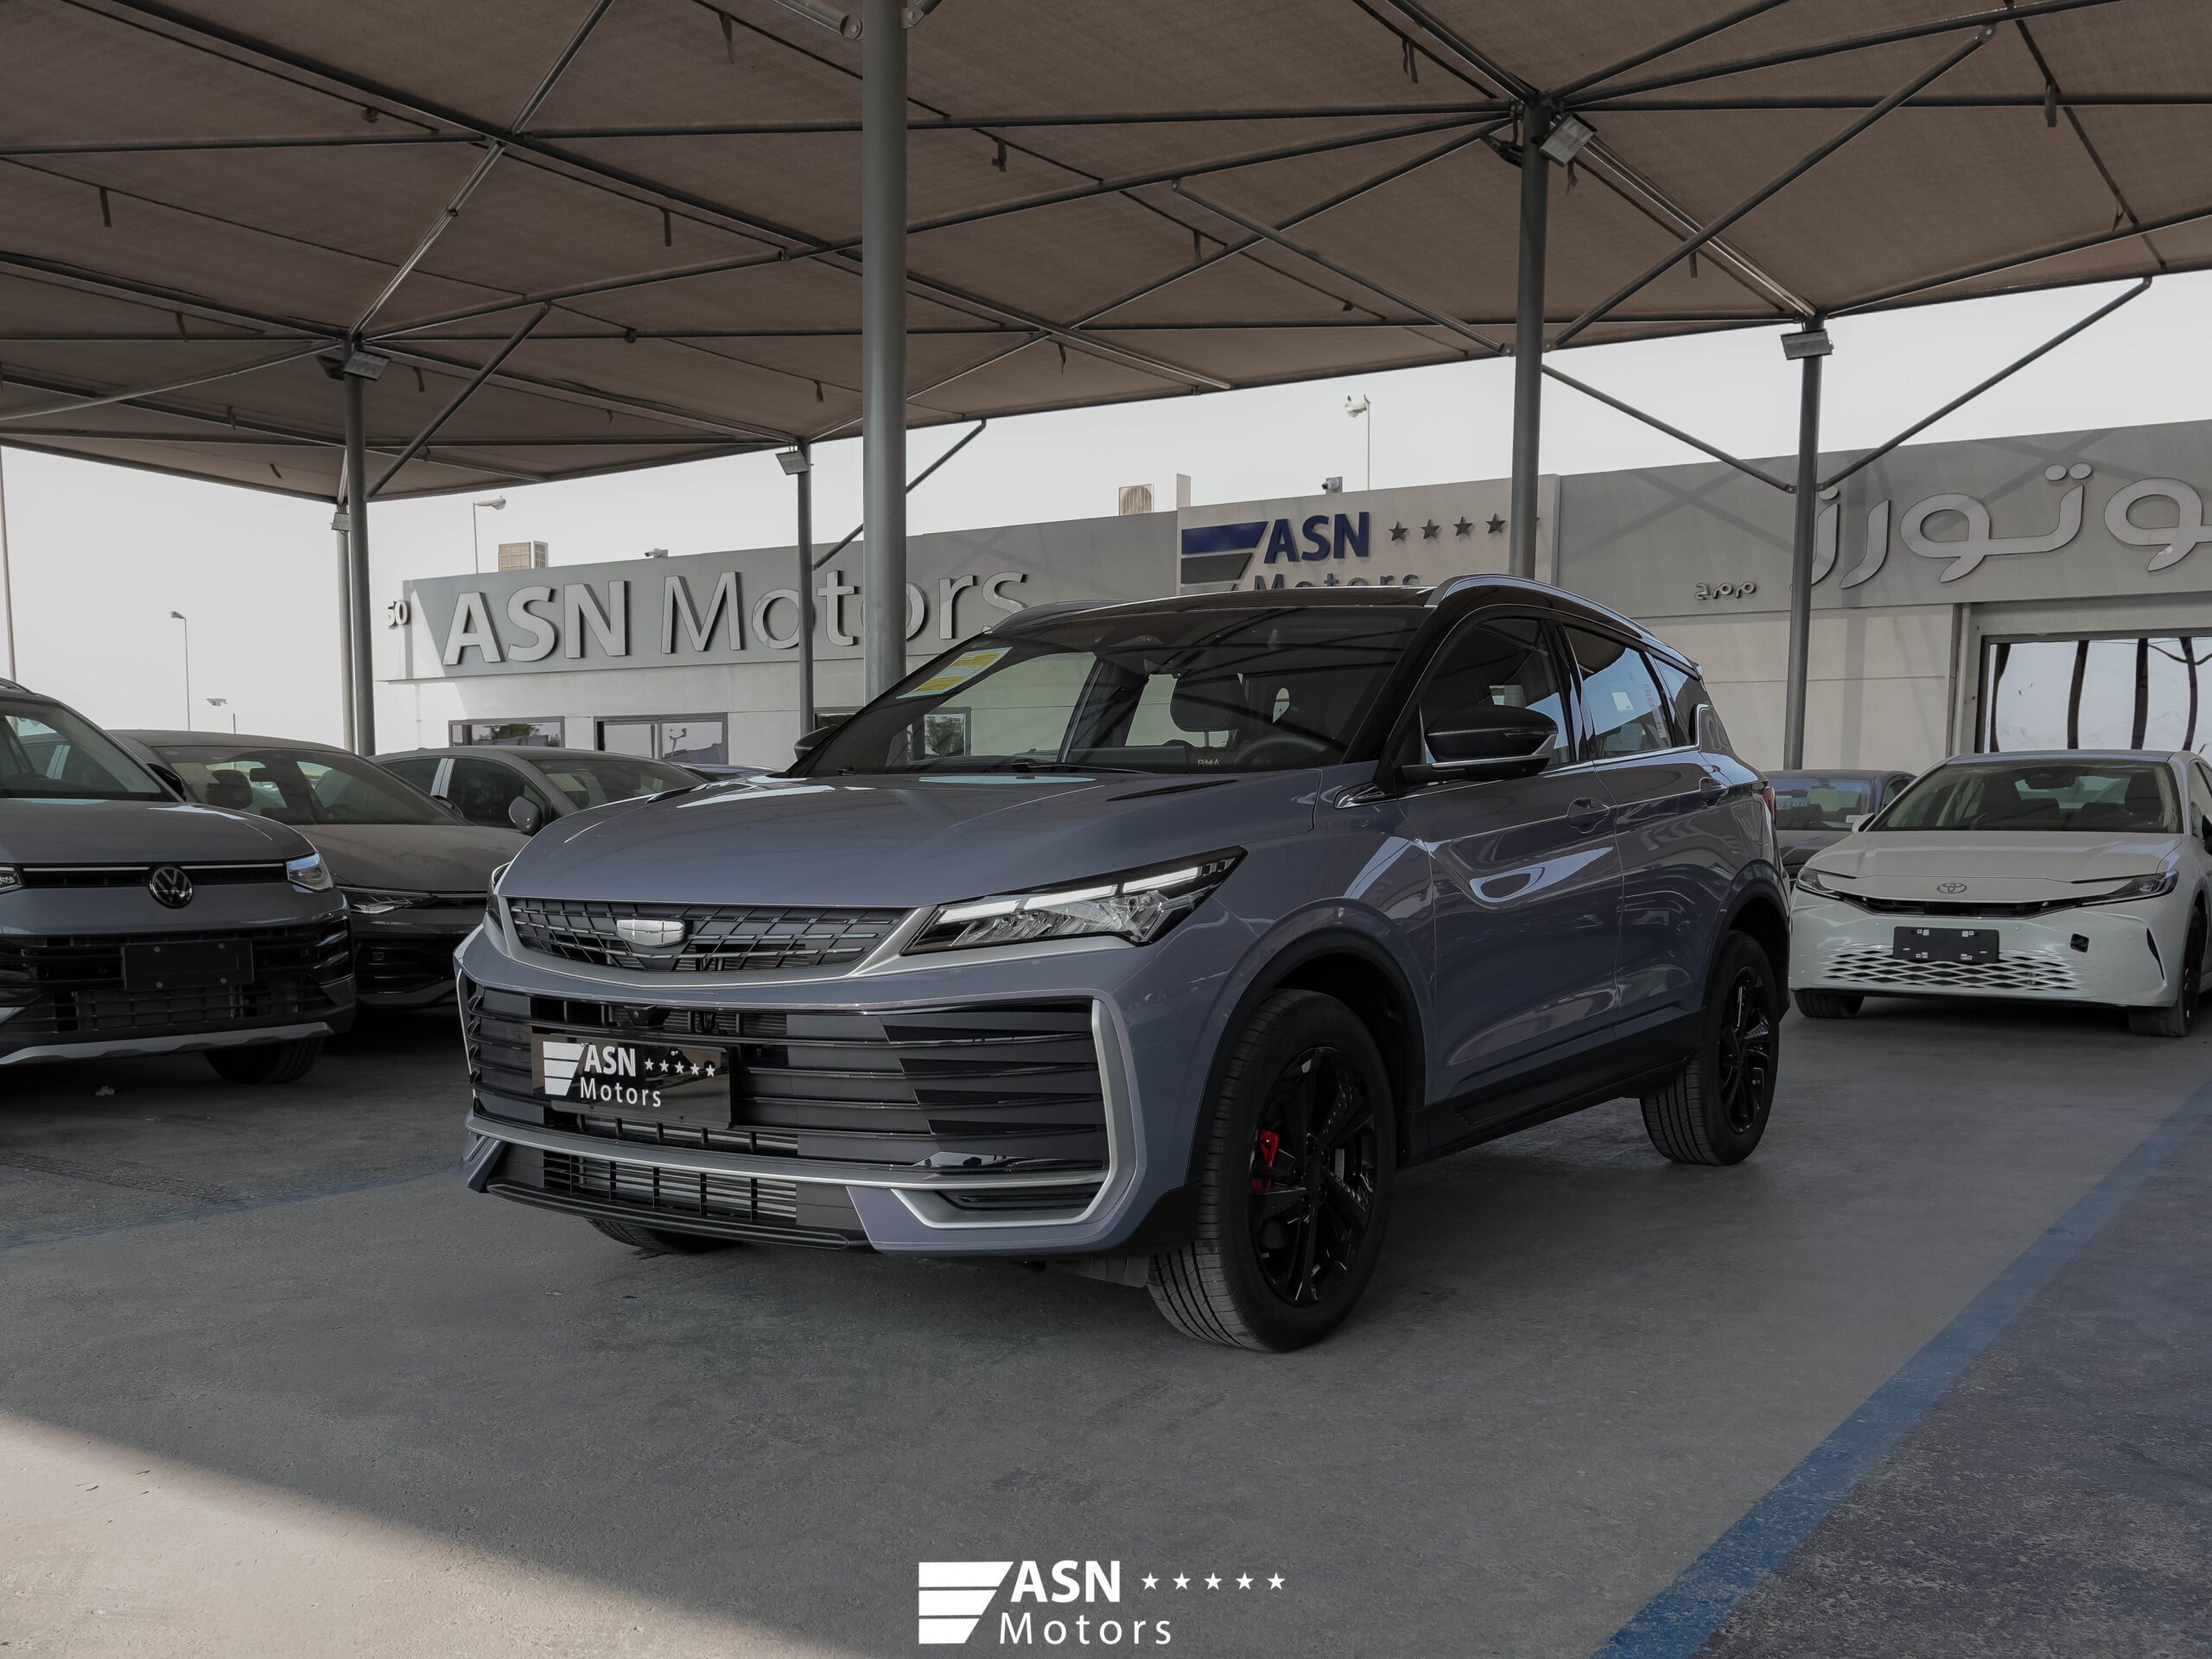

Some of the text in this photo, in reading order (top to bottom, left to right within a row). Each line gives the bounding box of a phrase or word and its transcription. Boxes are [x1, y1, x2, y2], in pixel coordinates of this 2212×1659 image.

[1263, 512, 1370, 563] ASN
[1790, 462, 2212, 589] وتورز
[442, 580, 628, 665] ASN
[584, 1045, 636, 1077] ASN
[580, 1077, 662, 1108] Motors
